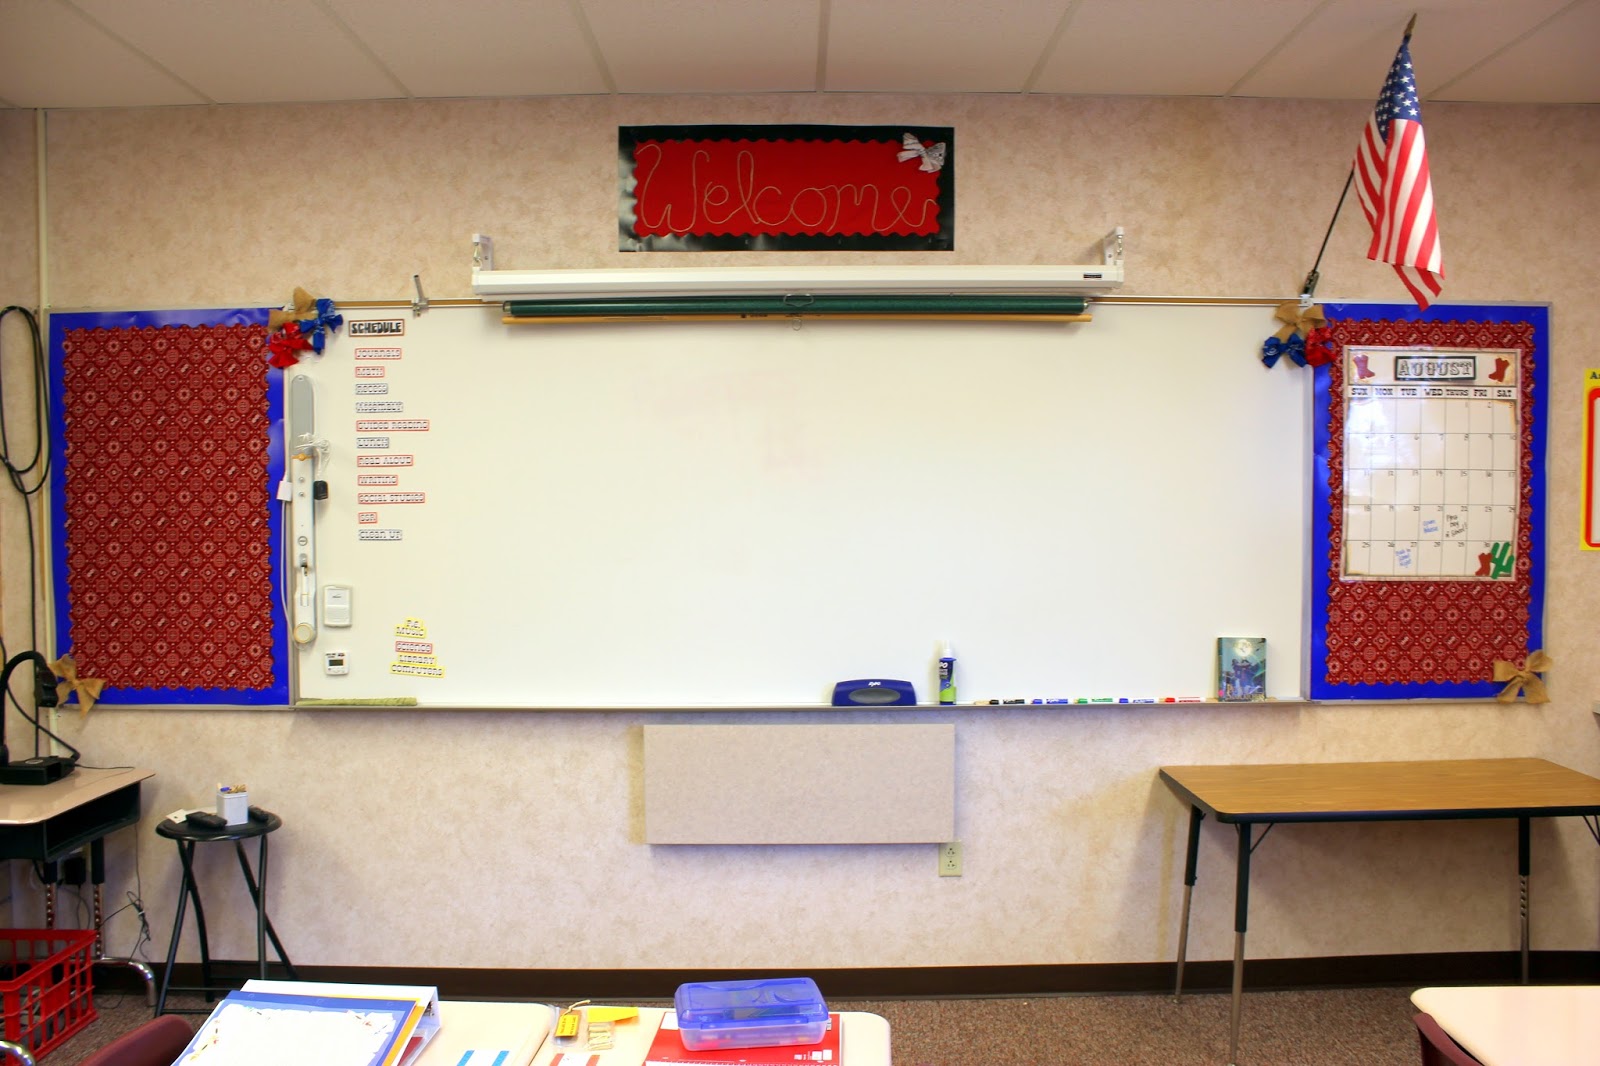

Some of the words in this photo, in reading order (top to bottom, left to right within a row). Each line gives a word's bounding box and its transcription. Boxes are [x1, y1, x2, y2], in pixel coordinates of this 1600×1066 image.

[636, 144, 937, 232] Welcome
[351, 321, 402, 334] SCHEDULE
[1398, 360, 1473, 377] AUGUST
[1351, 387, 1368, 396] SUN
[1375, 387, 1393, 396] MON
[1401, 388, 1417, 396] TUE
[1424, 388, 1443, 397] WED
[1446, 388, 1469, 397] THURS
[1473, 389, 1488, 397] FRI
[1497, 389, 1512, 398] SAT
